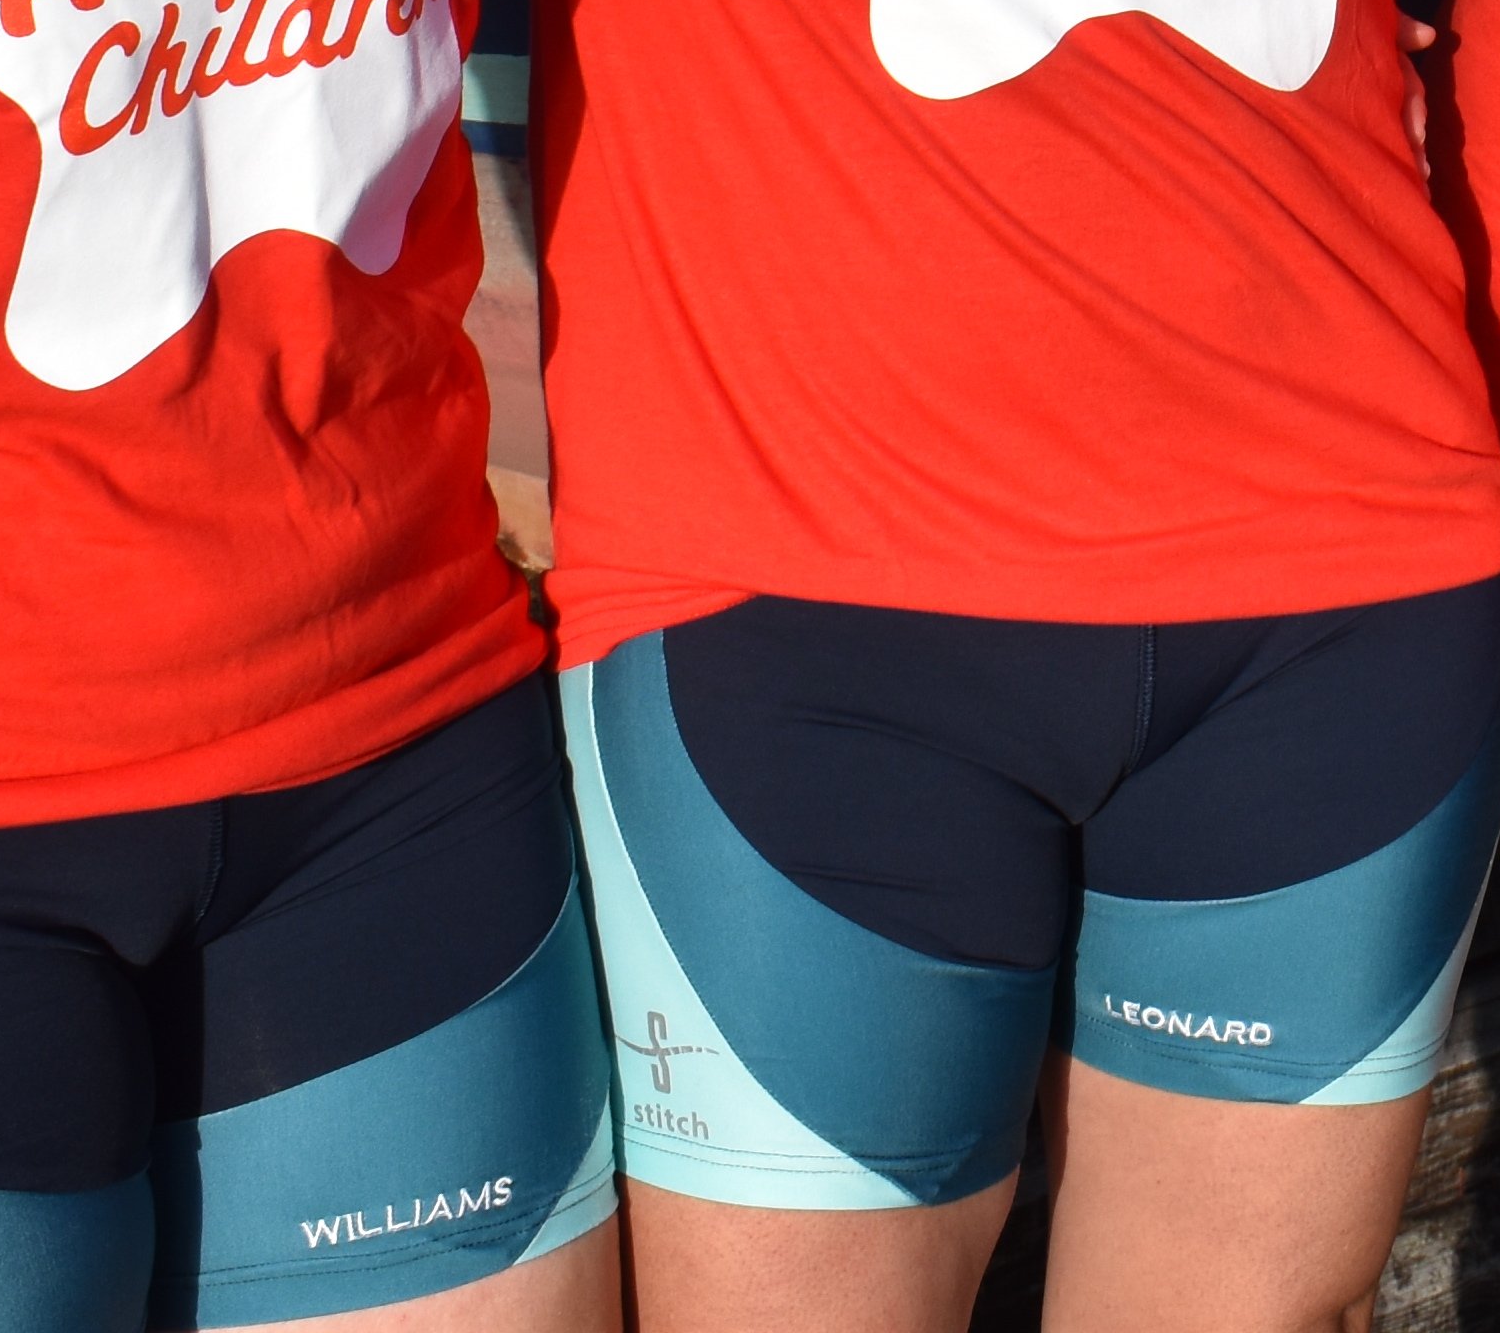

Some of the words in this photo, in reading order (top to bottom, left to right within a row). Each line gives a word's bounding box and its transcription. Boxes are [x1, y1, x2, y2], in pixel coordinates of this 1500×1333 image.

[1104, 994, 1273, 1046] LEONARD
[633, 1103, 709, 1140] stitch
[300, 1176, 514, 1249] WILLIAMS
